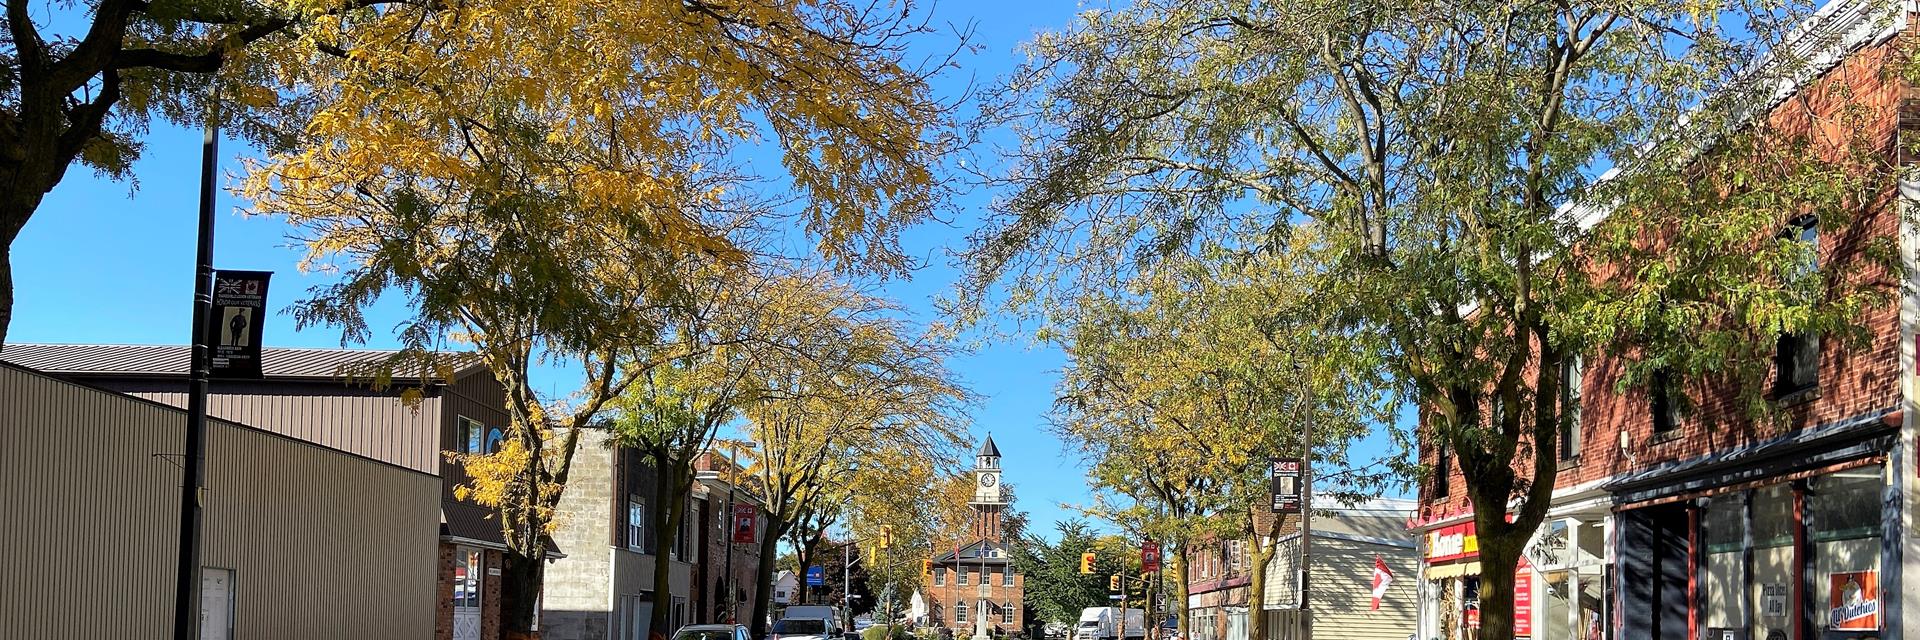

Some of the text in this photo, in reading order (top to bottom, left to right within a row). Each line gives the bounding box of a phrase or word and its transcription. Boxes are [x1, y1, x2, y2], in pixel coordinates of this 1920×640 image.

[1763, 584, 1775, 596] Pizza
[1775, 600, 1783, 616] Day
[1843, 600, 1876, 620] Dutchies
